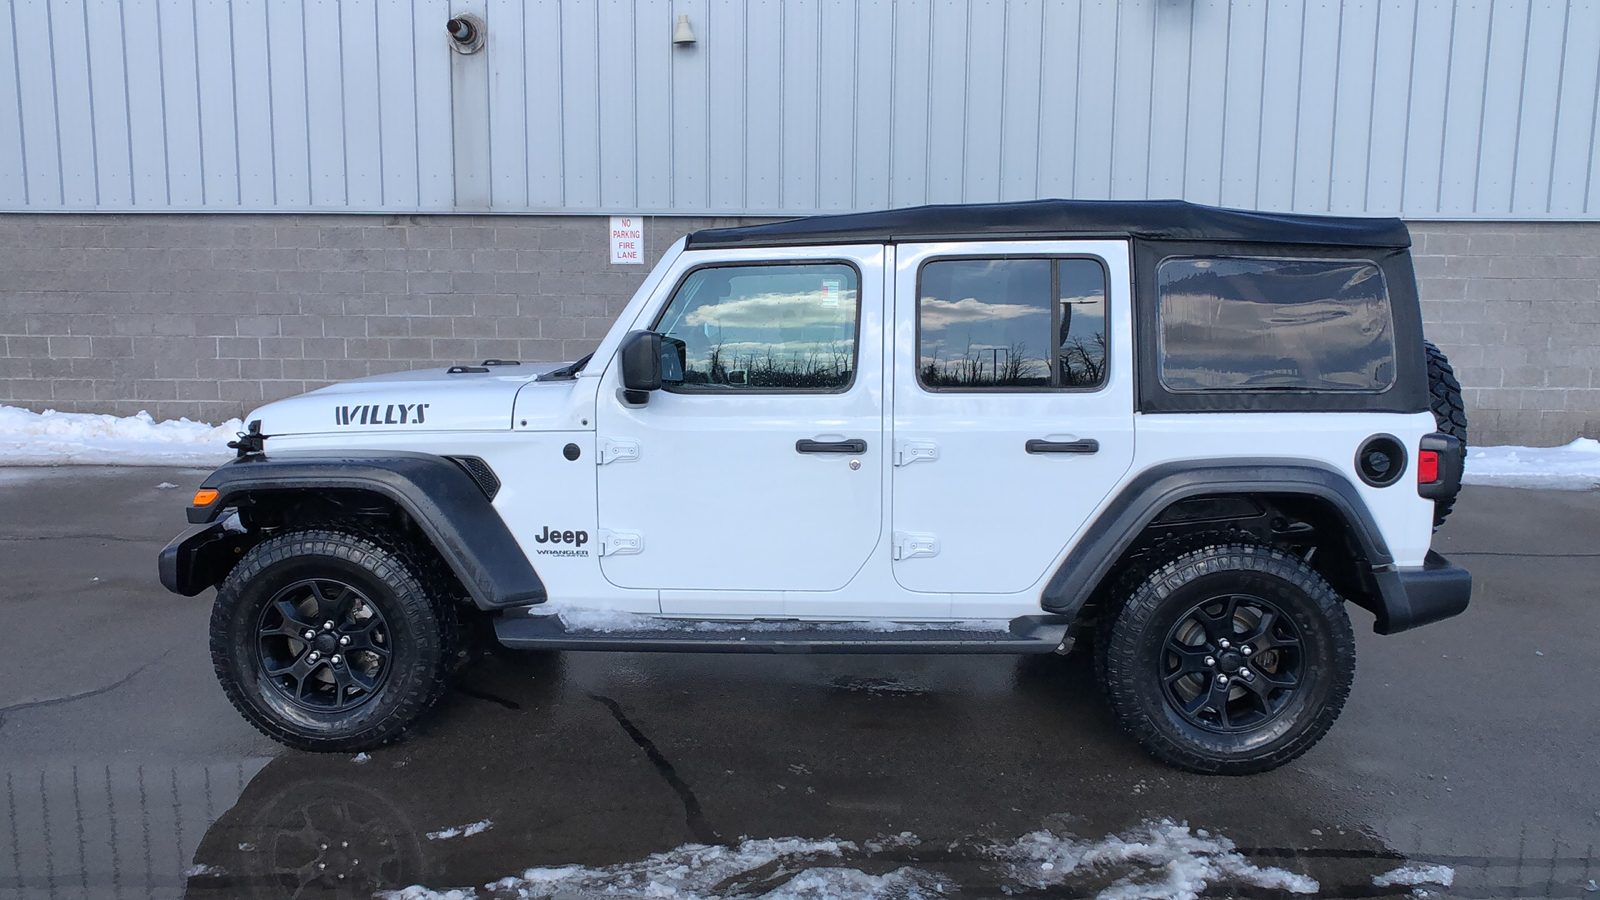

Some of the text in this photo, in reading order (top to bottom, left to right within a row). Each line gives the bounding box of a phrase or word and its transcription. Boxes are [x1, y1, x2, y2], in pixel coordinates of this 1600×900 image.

[621, 219, 631, 227] NO
[613, 230, 640, 239] PARKING
[617, 251, 637, 259] LANE
[335, 404, 430, 425] WILLYS
[534, 525, 589, 547] Jeep
